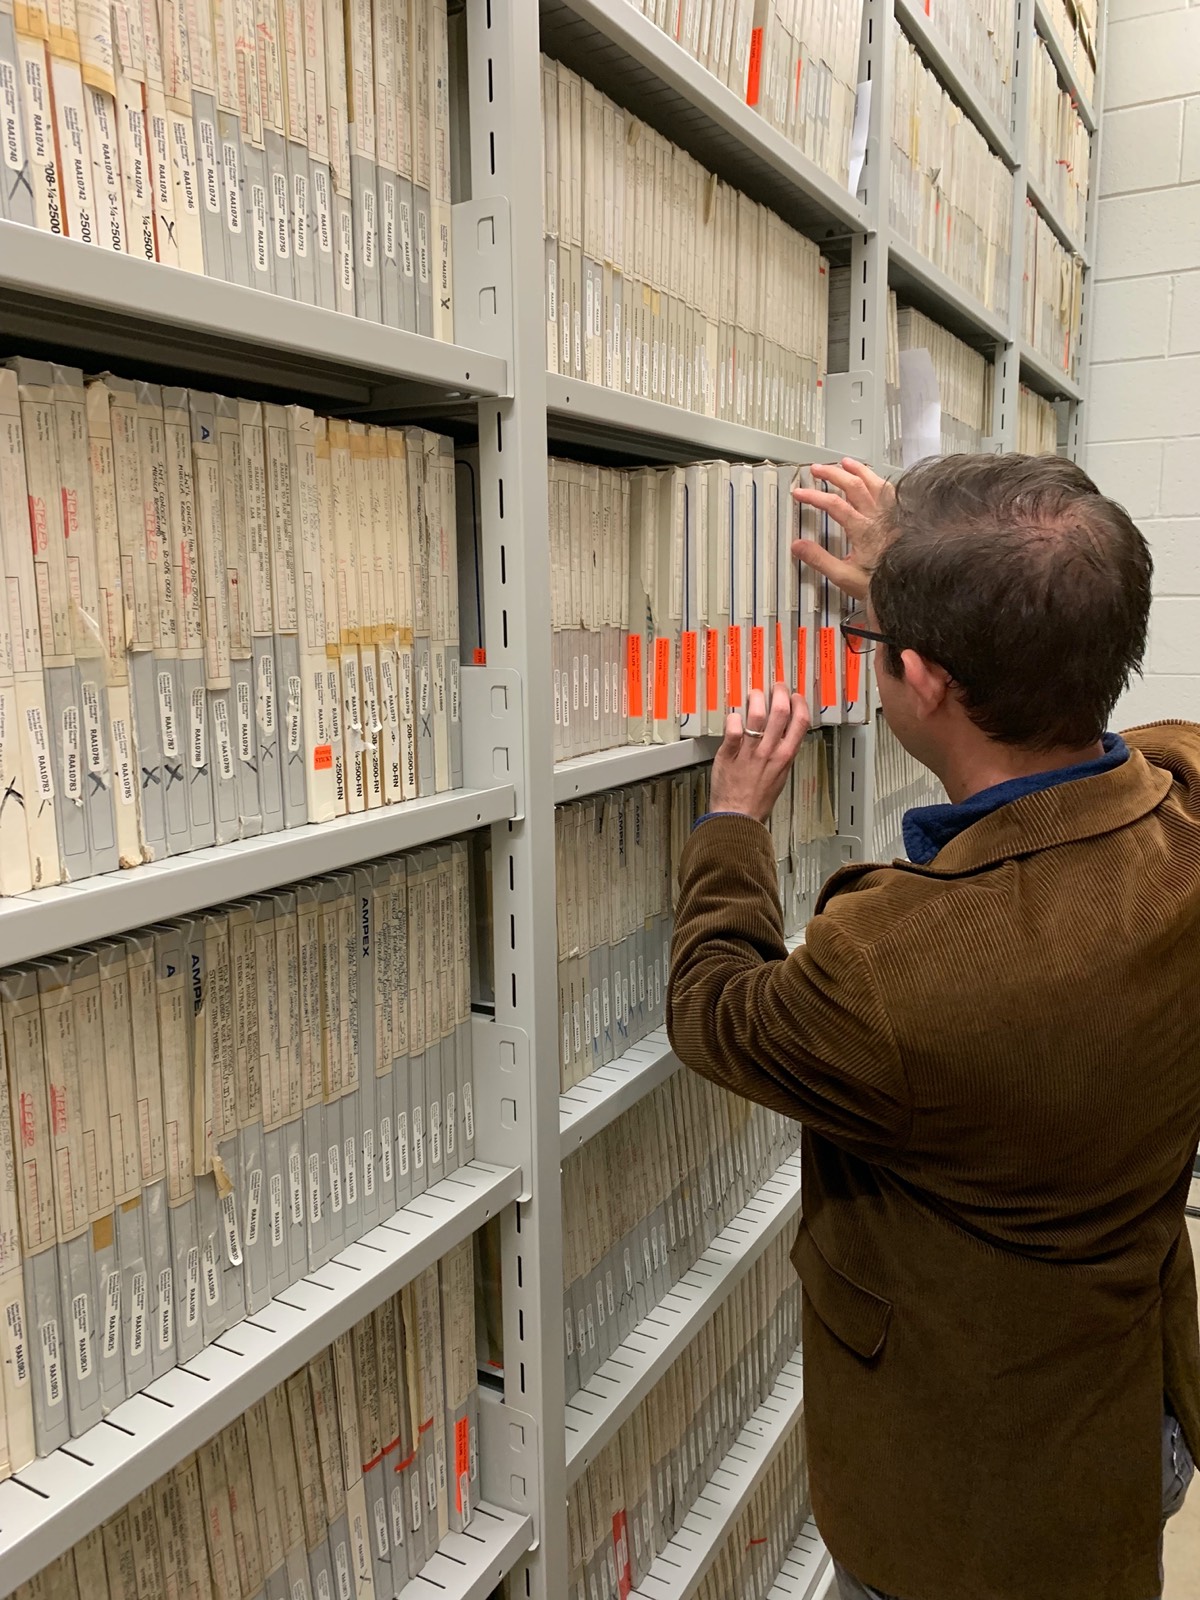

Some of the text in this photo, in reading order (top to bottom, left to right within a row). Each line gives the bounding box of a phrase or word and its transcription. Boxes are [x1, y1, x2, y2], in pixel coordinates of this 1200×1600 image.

[7, 119, 17, 162] RAA10740
[34, 114, 44, 156] RAA10741
[74, 159, 86, 200] RAA10742
[102, 143, 114, 185] RAA10743
[134, 159, 143, 198] RAA10744
[159, 164, 167, 202] RAA10745
[183, 171, 194, 208] RAA10746
[208, 169, 216, 206] RAA10747
[230, 191, 238, 226] RAA10748
[201, 426, 209, 440] A
[35, 498, 48, 550] STEREO
[67, 489, 78, 532] STEREO
[146, 500, 158, 560] STEREO
[90, 729, 99, 765] RAA10784
[166, 716, 174, 750] RAA10787
[38, 755, 49, 792] RAA10782
[221, 741, 230, 773] RAA10789
[122, 763, 131, 798] RAA10785
[192, 954, 203, 1017] AMPE
[229, 1230, 239, 1260] RAA10830
[207, 1269, 216, 1299] RAA10829
[108, 1316, 116, 1350] RAA10825
[15, 1345, 25, 1379] RAA10822
[79, 1338, 88, 1372] RAA10824
[50, 1364, 58, 1399] RAA10823
